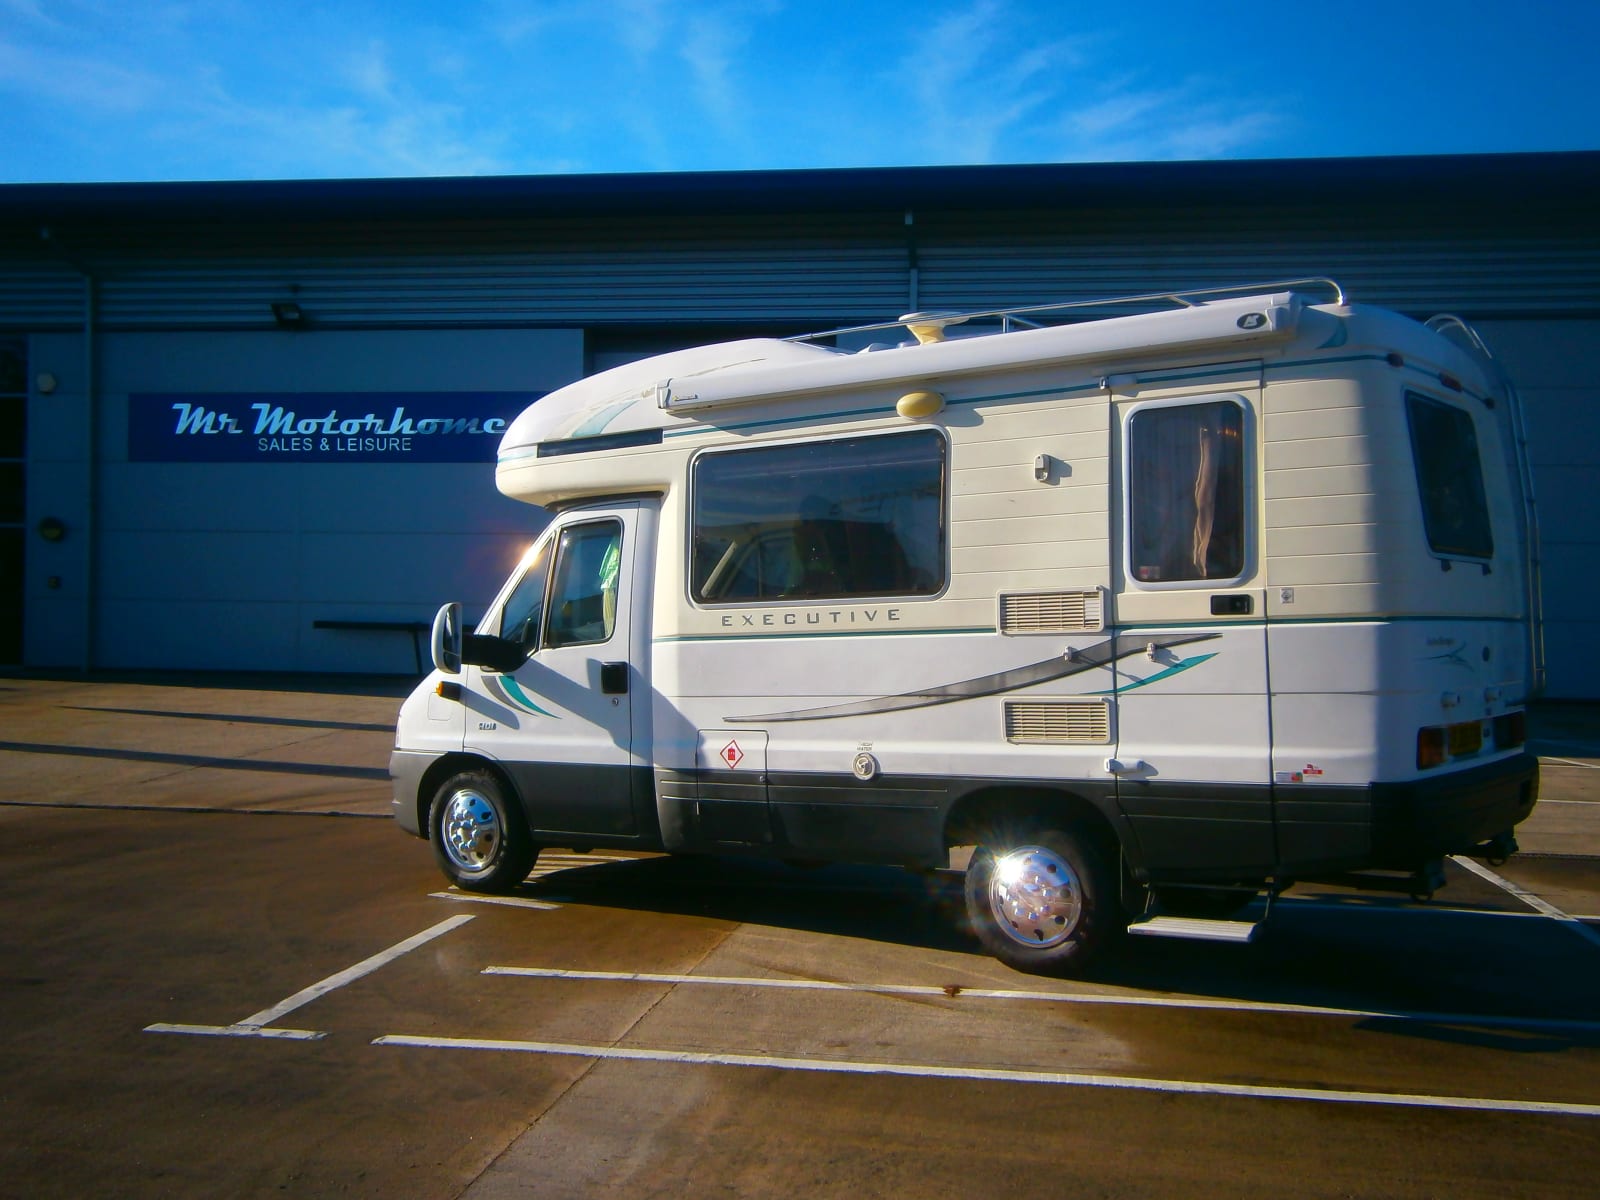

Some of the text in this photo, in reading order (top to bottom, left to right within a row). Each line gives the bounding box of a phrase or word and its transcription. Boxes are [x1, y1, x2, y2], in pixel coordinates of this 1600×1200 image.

[172, 402, 505, 434] Mr Motorhome
[258, 438, 412, 453] SALES & LEISURE
[722, 609, 901, 627] EXECUTIVE
